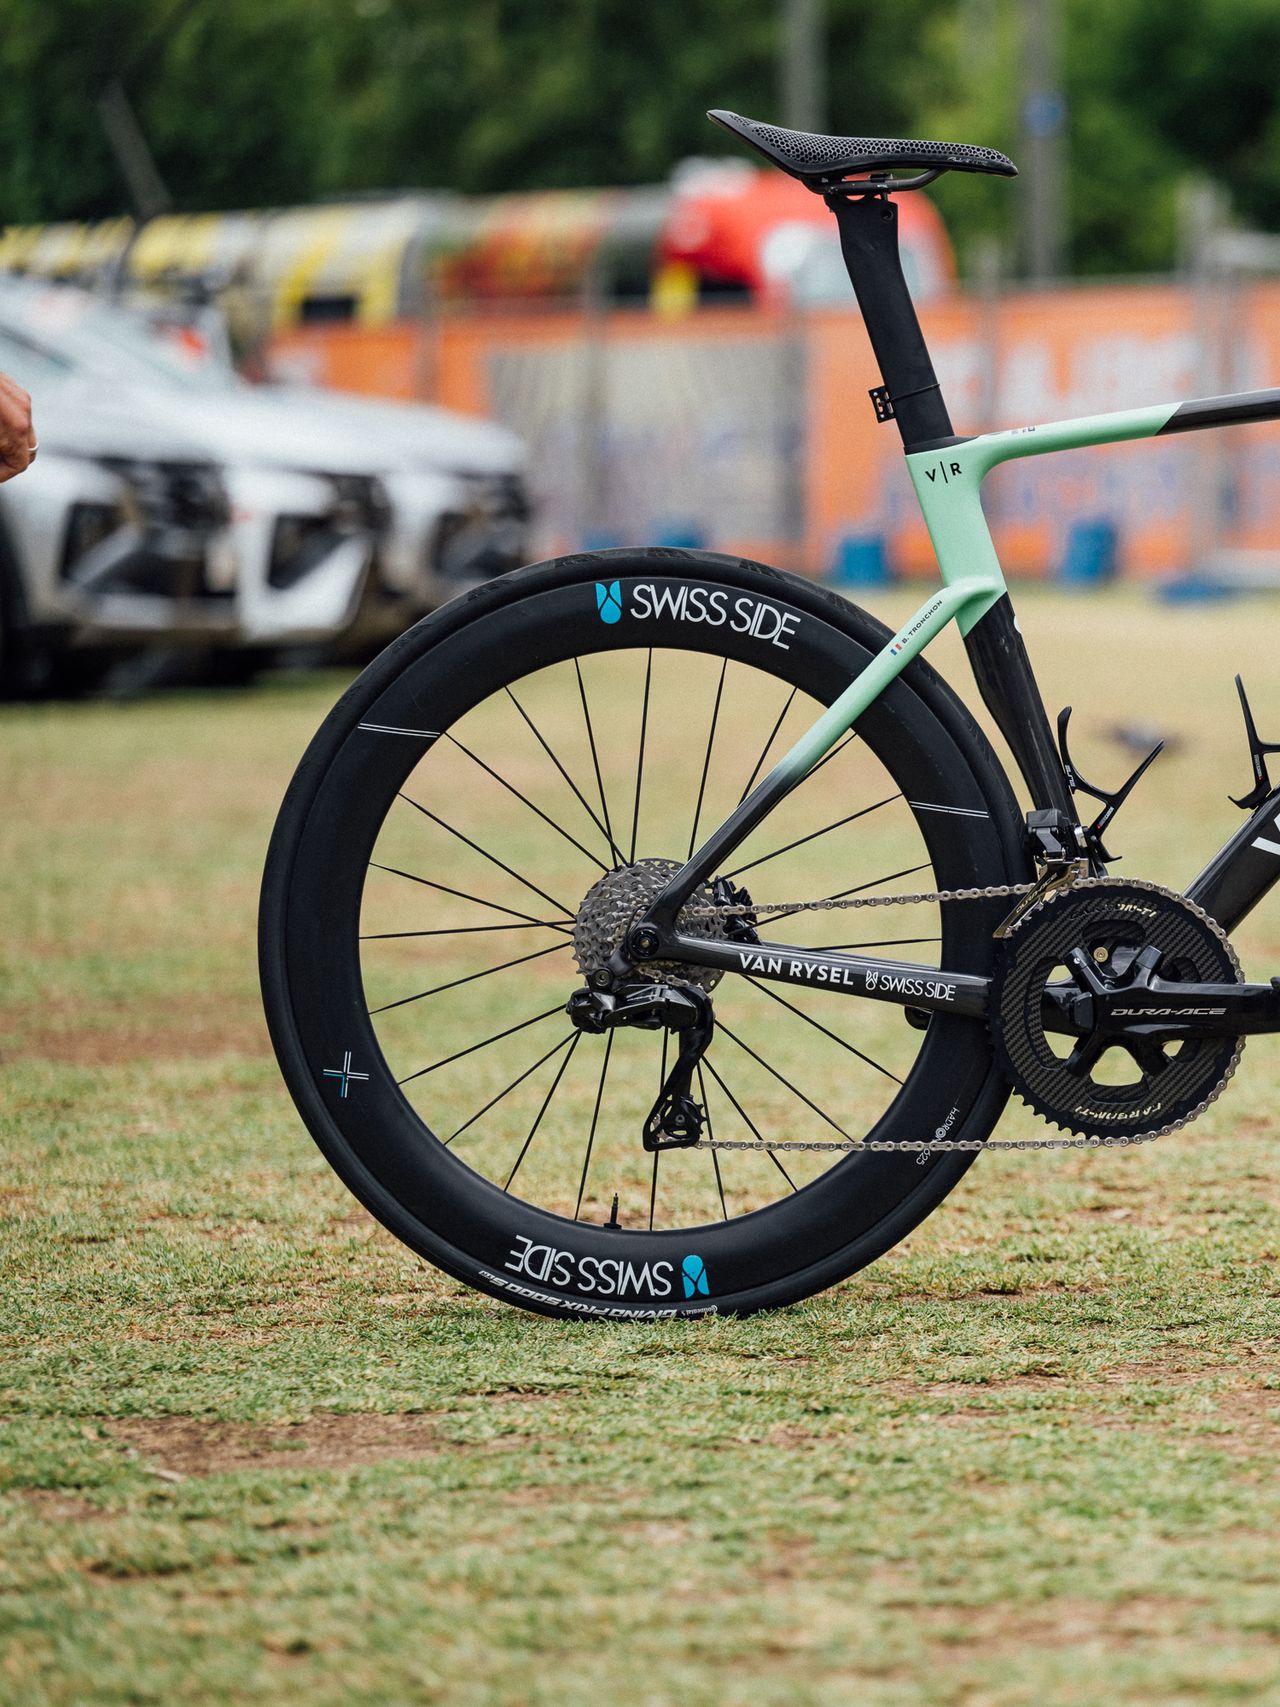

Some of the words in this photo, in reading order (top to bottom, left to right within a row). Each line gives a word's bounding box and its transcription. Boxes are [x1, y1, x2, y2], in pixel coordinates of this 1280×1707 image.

[630, 584, 729, 626] SWISS
[730, 598, 801, 650] SIDE
[908, 599, 943, 637] TRONCHON
[739, 953, 782, 974] VAN
[789, 961, 854, 986] RYSEL
[880, 975, 924, 995] SWISS
[924, 982, 957, 1001] SIDE
[1110, 1007, 1227, 1016] DURA-ACE
[504, 1234, 576, 1286] SIDE
[577, 1256, 674, 1297] SWISS
[504, 1282, 562, 1306] 5000
[560, 1300, 610, 1315] PRIX
